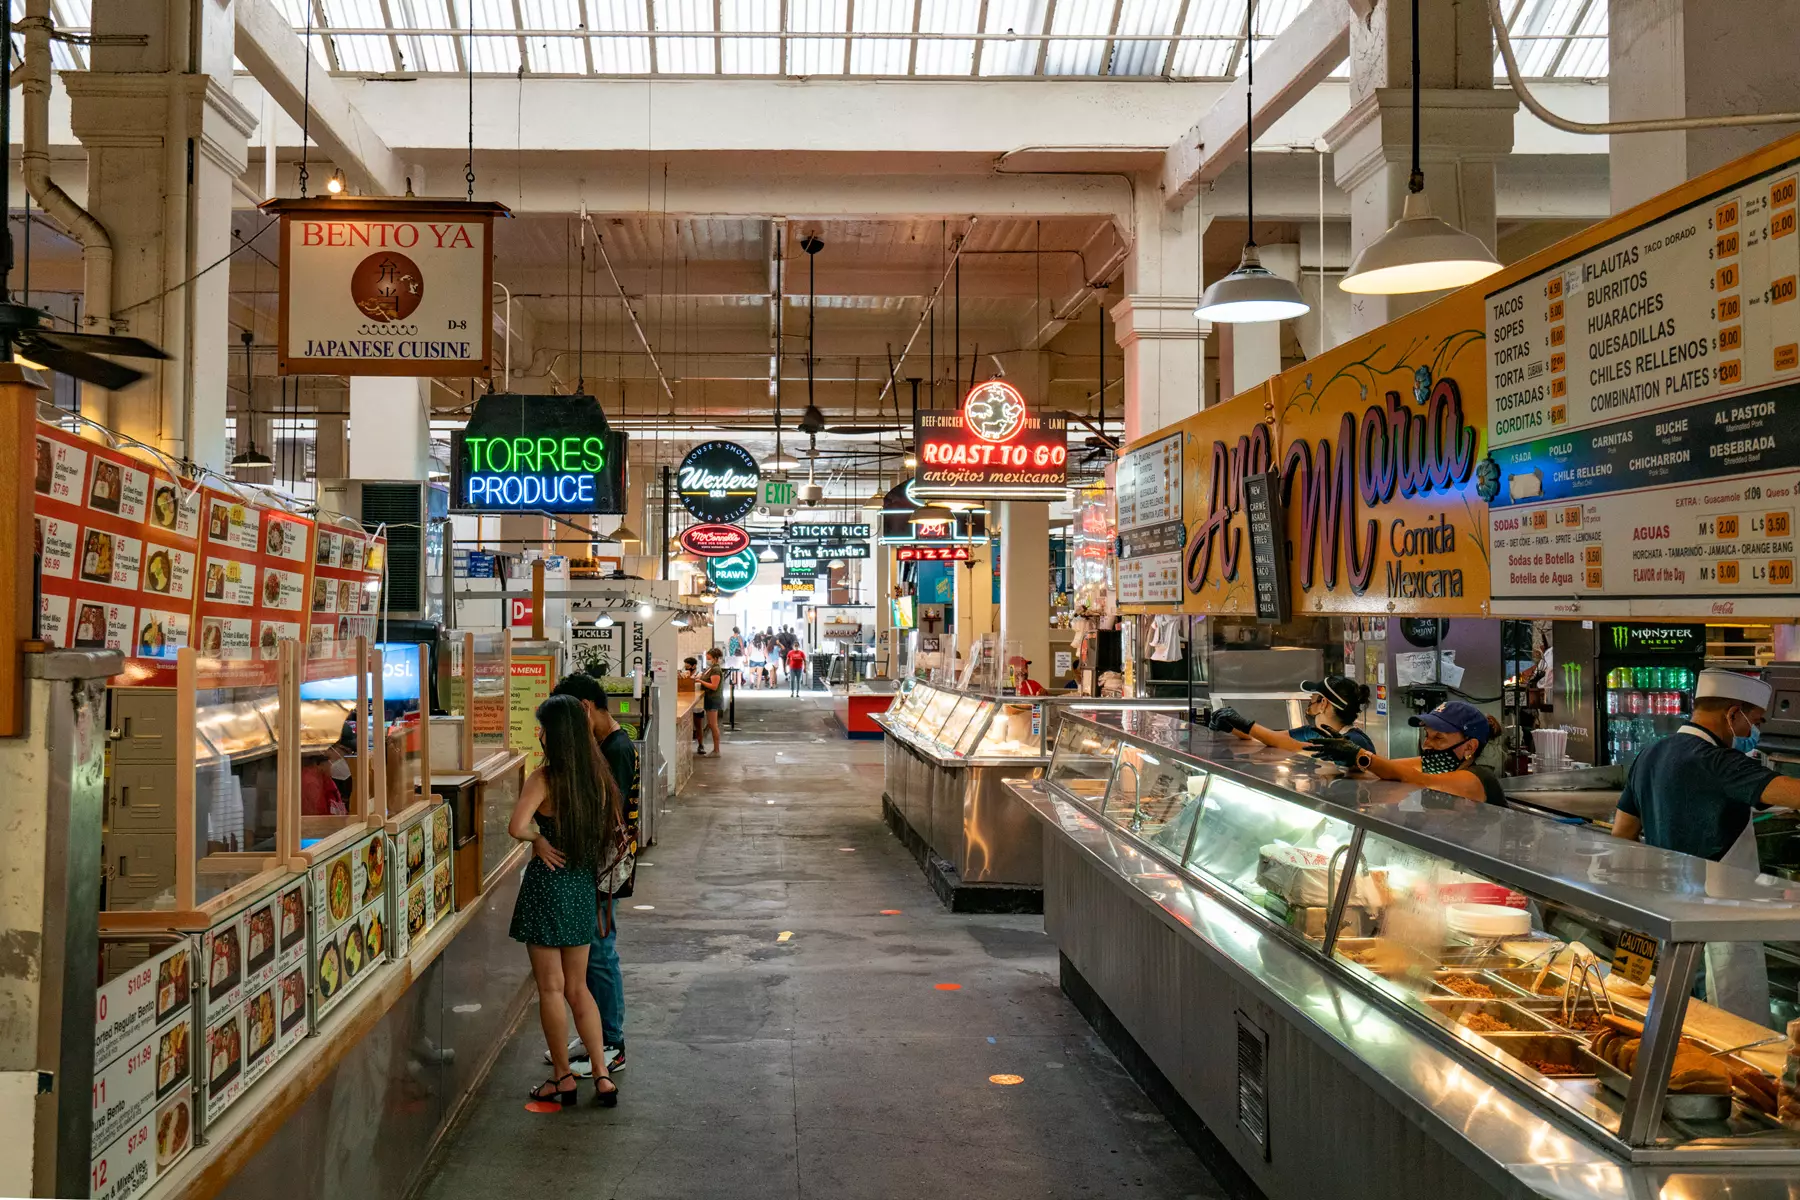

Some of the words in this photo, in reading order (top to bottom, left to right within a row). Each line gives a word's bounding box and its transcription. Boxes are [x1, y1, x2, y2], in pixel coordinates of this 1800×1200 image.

[302, 222, 418, 247] BENTO
[427, 225, 474, 249] YA
[1586, 246, 1639, 282] FLAUTAS
[1644, 240, 1662, 255] TACO
[1665, 226, 1696, 246] DORADO
[1587, 270, 1647, 308] BURRITOS
[1494, 295, 1524, 320] TACOS
[1588, 293, 1664, 334] HUARACHES
[447, 319, 467, 331] D-8
[1494, 319, 1524, 343] SOPES
[304, 340, 394, 358] JAPANESE
[399, 340, 471, 358] CUISINE
[1589, 318, 1675, 360] QUESADILLAS
[1494, 341, 1530, 366] TORTAS
[1590, 360, 1632, 386] CHILES
[1636, 338, 1708, 374] RELLENOS
[1495, 367, 1524, 389] TORTA
[1495, 385, 1544, 412] TOSTADAS
[1590, 380, 1660, 412] COMBINATION
[1665, 367, 1710, 395] PLATES
[1496, 410, 1543, 435] GORDITAS
[1510, 452, 1532, 464] ASADA
[1548, 443, 1573, 457] POLLO
[1592, 431, 1634, 449] CARNITAS
[1655, 418, 1689, 437] BUCHE
[1714, 412, 1729, 425] AL
[1731, 401, 1776, 422] PASTOR
[465, 437, 604, 473] TORRES
[686, 443, 713, 464] HOUSE
[725, 444, 753, 467] SMOKED
[923, 443, 995, 465] ROAST
[999, 445, 1028, 465] TO
[1033, 445, 1066, 465] GO
[1553, 468, 1575, 482] CHILE
[1577, 463, 1613, 479] RELLENO
[1629, 450, 1691, 471] CHICHARRON
[1709, 435, 1776, 458] DESEBRADA
[679, 467, 758, 489] Wexler's
[989, 470, 1065, 484] mexicanos
[1280, 377, 1476, 598] Maria
[468, 475, 594, 504] PRODUCE
[765, 482, 791, 505] EXIT
[1250, 486, 1260, 495] NEW
[1703, 492, 1741, 505] Guacamole
[1765, 489, 1790, 499] Queso
[684, 497, 712, 521] HAND
[724, 497, 753, 521] SLICED
[1250, 501, 1266, 511] CARNE
[48, 522, 58, 536] #2
[792, 526, 835, 536] STICKY
[842, 526, 869, 536] RICE
[1252, 523, 1270, 532] FRENCH
[1389, 513, 1456, 557] Comida
[1494, 518, 1519, 532] SODAS
[1632, 525, 1671, 541] AGUAS
[1254, 535, 1268, 544] FRIES
[1494, 539, 1505, 549] COKE
[1519, 538, 1531, 547] COKE
[1535, 536, 1549, 546] FANTA
[1555, 534, 1571, 544] SPRITE
[1632, 549, 1663, 560] HORCHATA
[1741, 542, 1771, 555] ORANGE
[1772, 541, 1793, 554] BANG
[900, 549, 967, 559] PIZZA
[1255, 555, 1270, 564] SMALL
[1508, 553, 1532, 566] Sodas
[1533, 553, 1543, 566] de
[1545, 552, 1575, 565] Botella
[715, 570, 748, 579] PRAWN
[1256, 567, 1269, 575] TACO
[1386, 558, 1464, 600] Mexicana
[1510, 572, 1537, 584] Botella
[1539, 572, 1550, 584] de
[1551, 571, 1573, 586] Agua
[1633, 568, 1655, 582] FLAVOR
[1656, 569, 1663, 581] of
[1663, 568, 1673, 580] the
[1673, 567, 1686, 584] Day
[1258, 583, 1273, 592] CHIPS
[1260, 603, 1275, 613] SALSA
[577, 630, 610, 638] PICKLES
[633, 621, 644, 652] MEAT
[1631, 628, 1693, 639] MONSTER
[1620, 932, 1655, 958] CAUTION
[128, 968, 152, 996] $10.99
[114, 1011, 136, 1036] Regular
[137, 1000, 154, 1019] Bento
[128, 1045, 152, 1075] $11.99
[107, 1100, 126, 1121] Bento
[128, 1125, 148, 1155] $7.50
[116, 1168, 134, 1192] Mixed
[131, 1175, 148, 1192] Salad
